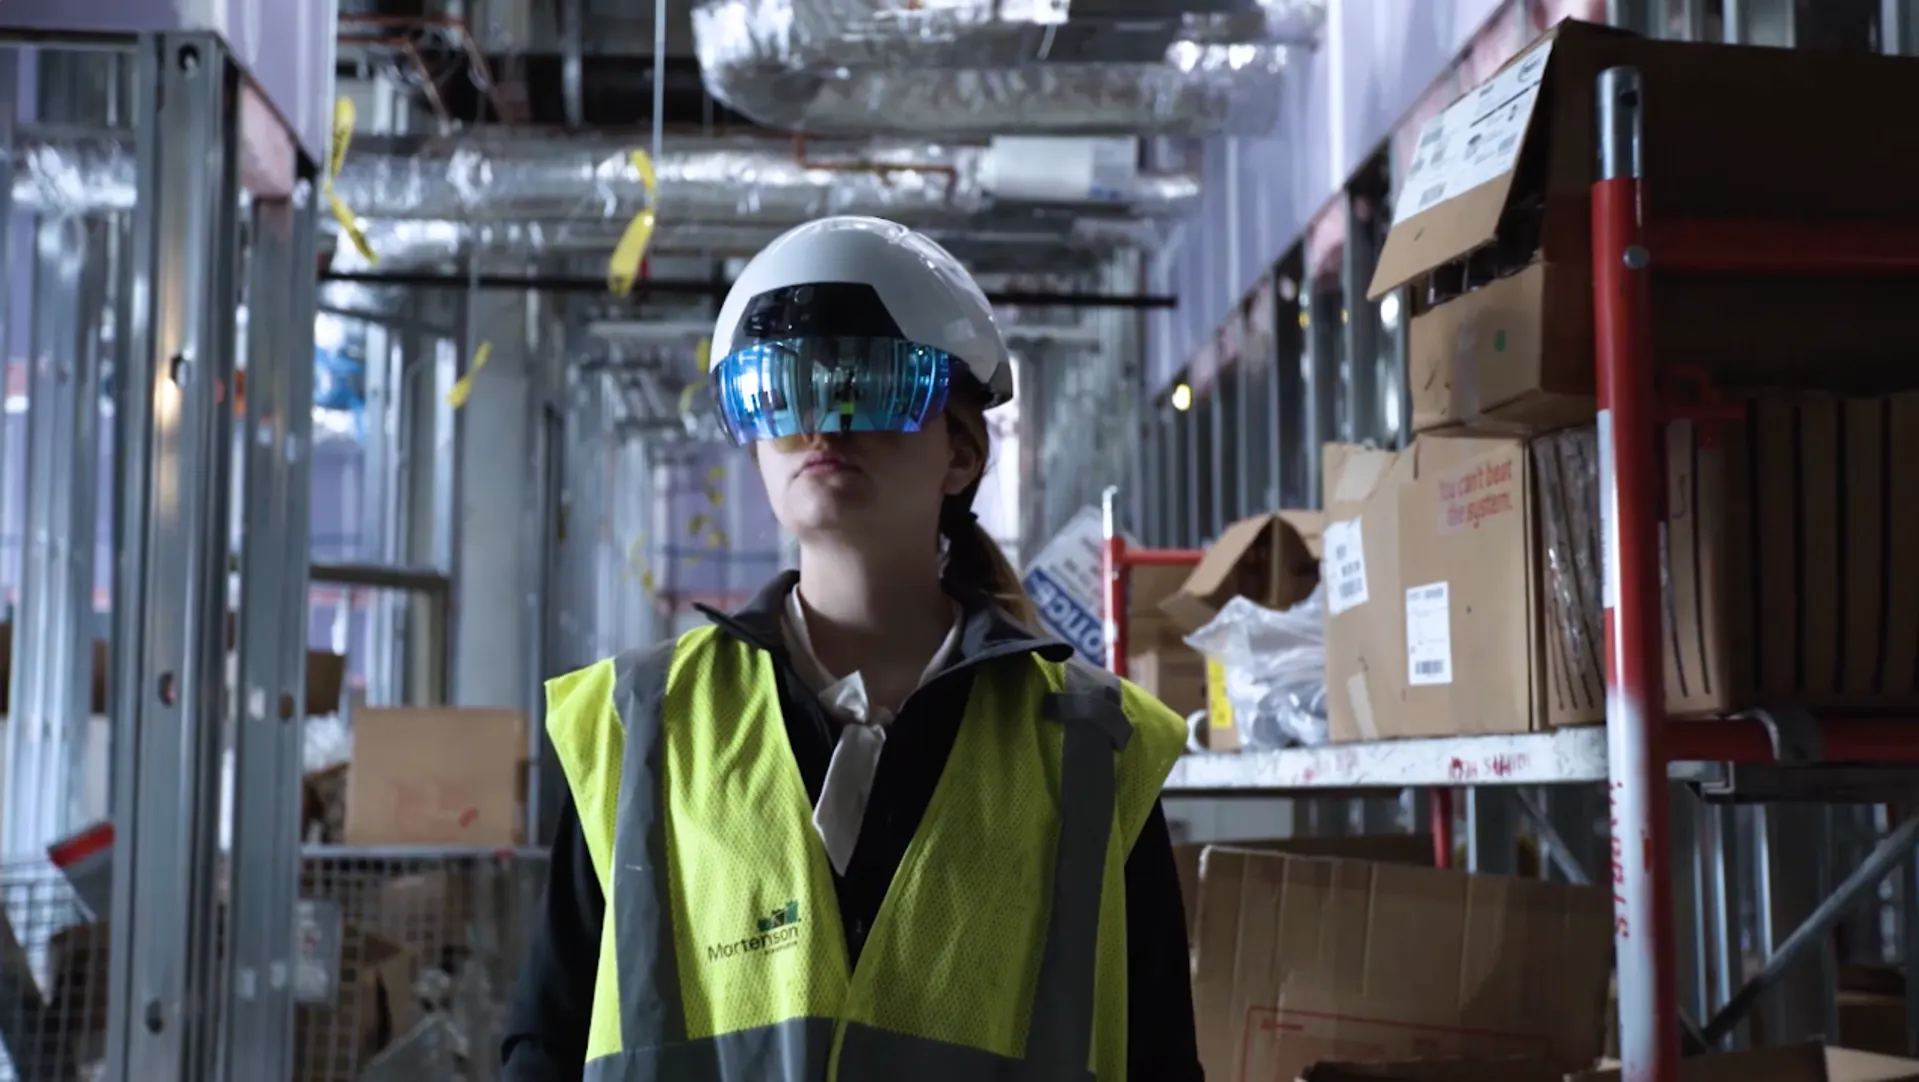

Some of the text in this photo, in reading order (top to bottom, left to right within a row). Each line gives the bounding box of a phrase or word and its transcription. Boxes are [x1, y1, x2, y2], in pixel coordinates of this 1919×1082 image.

[1486, 460, 1512, 487] beat
[1030, 577, 1106, 661] OTICE
[708, 925, 799, 962] Mortenson
